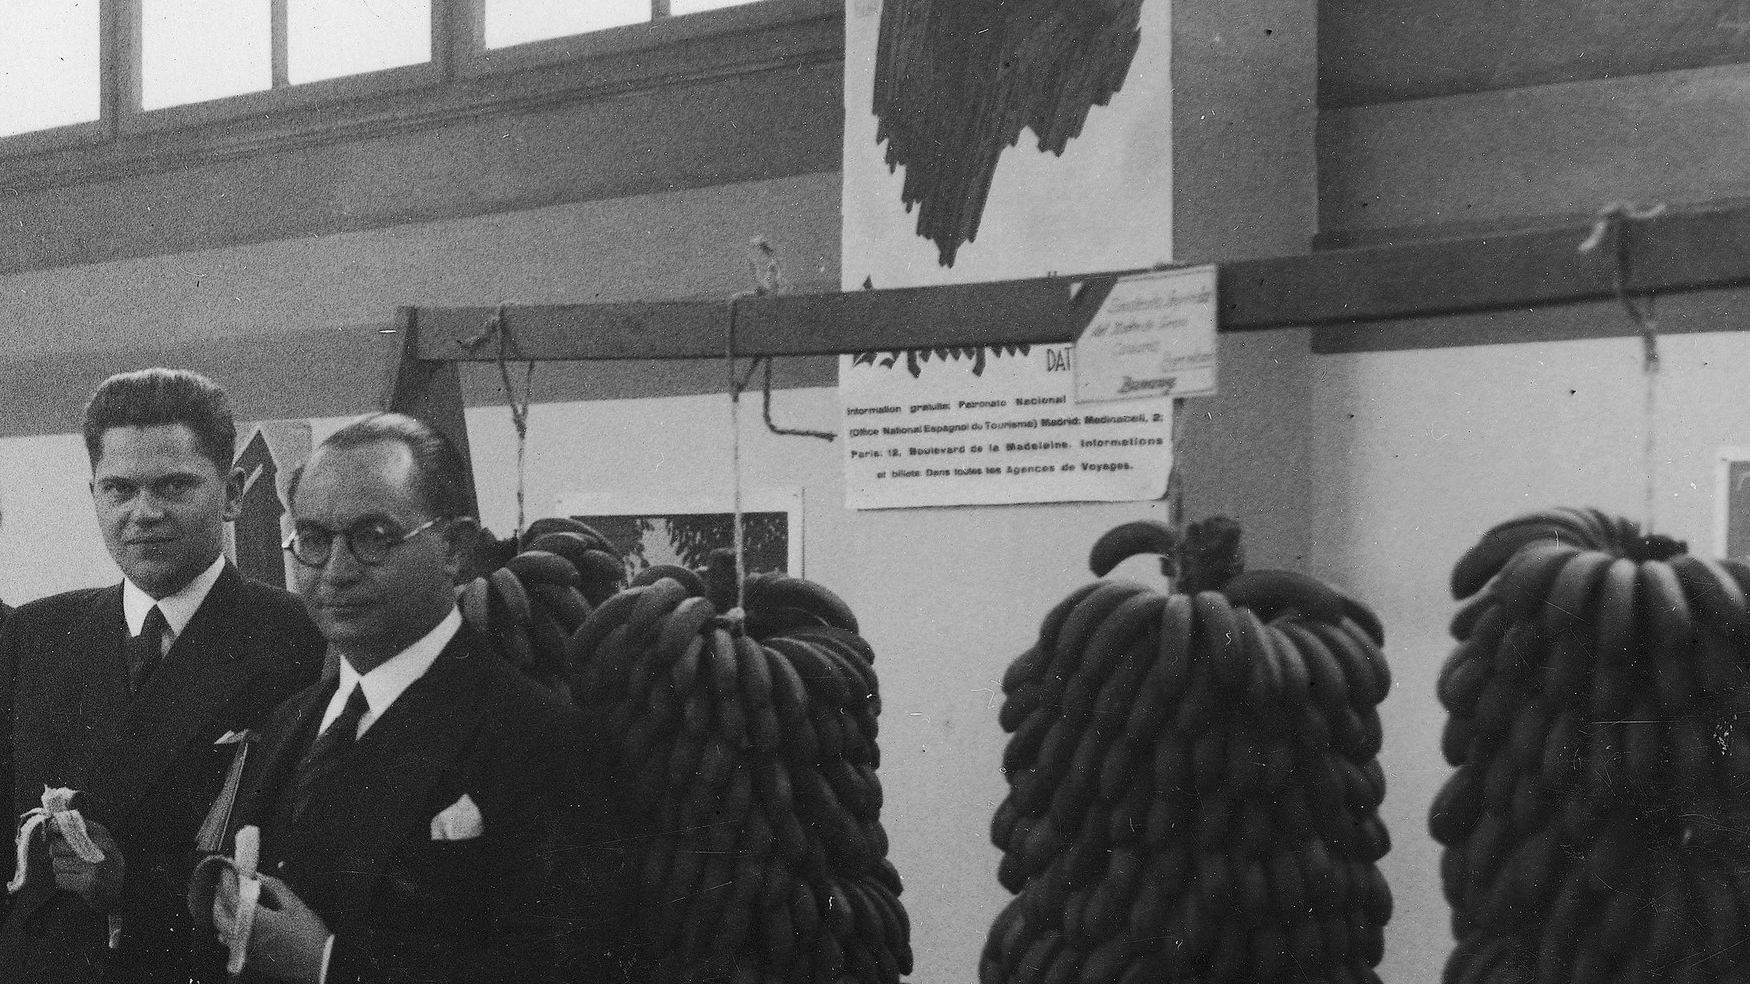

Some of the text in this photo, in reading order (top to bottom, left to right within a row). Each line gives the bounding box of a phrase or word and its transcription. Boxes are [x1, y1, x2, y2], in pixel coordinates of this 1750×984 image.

[1015, 394, 1067, 406] Nacional
[883, 424, 922, 436] National
[924, 423, 970, 434] Espagnol
[971, 421, 983, 431] du
[985, 419, 1038, 430] Tourisme)
[909, 445, 966, 456] Boulevard
[970, 444, 983, 454] de
[988, 443, 999, 453] la
[1080, 437, 1164, 448] Informations
[877, 470, 887, 479] et
[953, 466, 983, 476] toutes
[985, 466, 1001, 475] les
[1006, 463, 1056, 475] Agences
[1061, 462, 1076, 472] de
[1081, 461, 1134, 473] Voyages.
